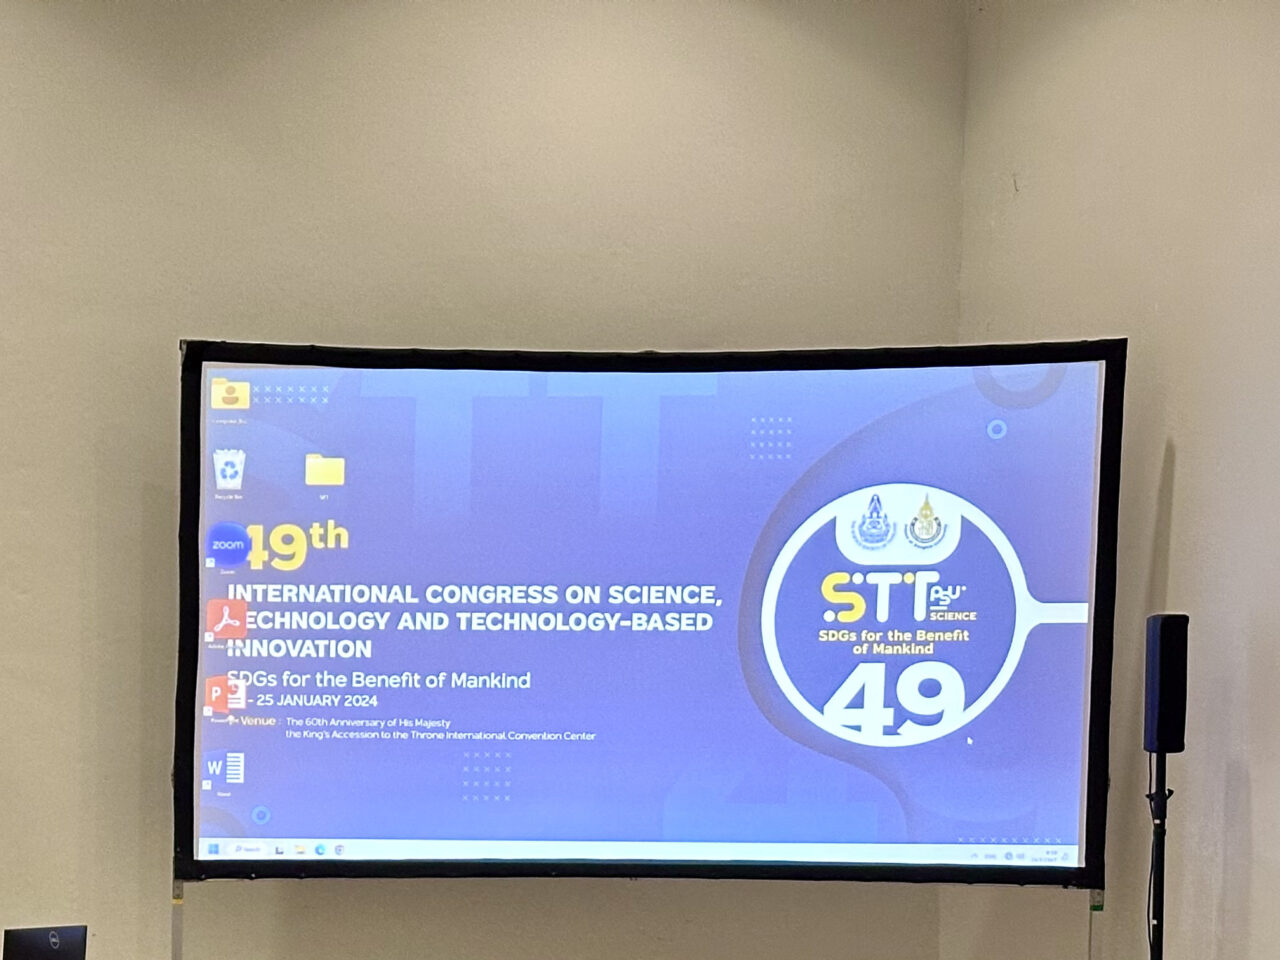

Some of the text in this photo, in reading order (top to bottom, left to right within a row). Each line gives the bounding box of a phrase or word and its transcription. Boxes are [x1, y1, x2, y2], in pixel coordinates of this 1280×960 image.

[212, 539, 245, 549] zoom
[228, 584, 723, 607] INTERNATIONAL CONGRESS ON SCIENCE,
[246, 611, 713, 632] ECHNOLOGY AND TECHNOLOGY-BASED
[930, 612, 977, 621] SCIENCE
[819, 629, 969, 642] SDGs for the Benefit
[227, 639, 372, 658] INNOVATION
[853, 643, 934, 655] of Mankind
[282, 671, 310, 687] for
[315, 671, 347, 688] the
[352, 672, 421, 688] Benefit
[425, 672, 447, 688] of
[451, 672, 531, 689] Mankind
[256, 695, 274, 707] 25
[277, 695, 341, 707] JANUARY
[344, 695, 378, 707] 2024
[823, 661, 966, 740] 49
[240, 716, 276, 726] Venue
[286, 717, 451, 730] The 60th Anniversary of His Majesty
[286, 730, 301, 739] the
[331, 731, 379, 740] Accession
[381, 731, 391, 740] to
[393, 731, 409, 740] the
[411, 731, 444, 740] Throne
[446, 731, 507, 740] International
[508, 731, 562, 741] Convention
[564, 731, 596, 741] Center
